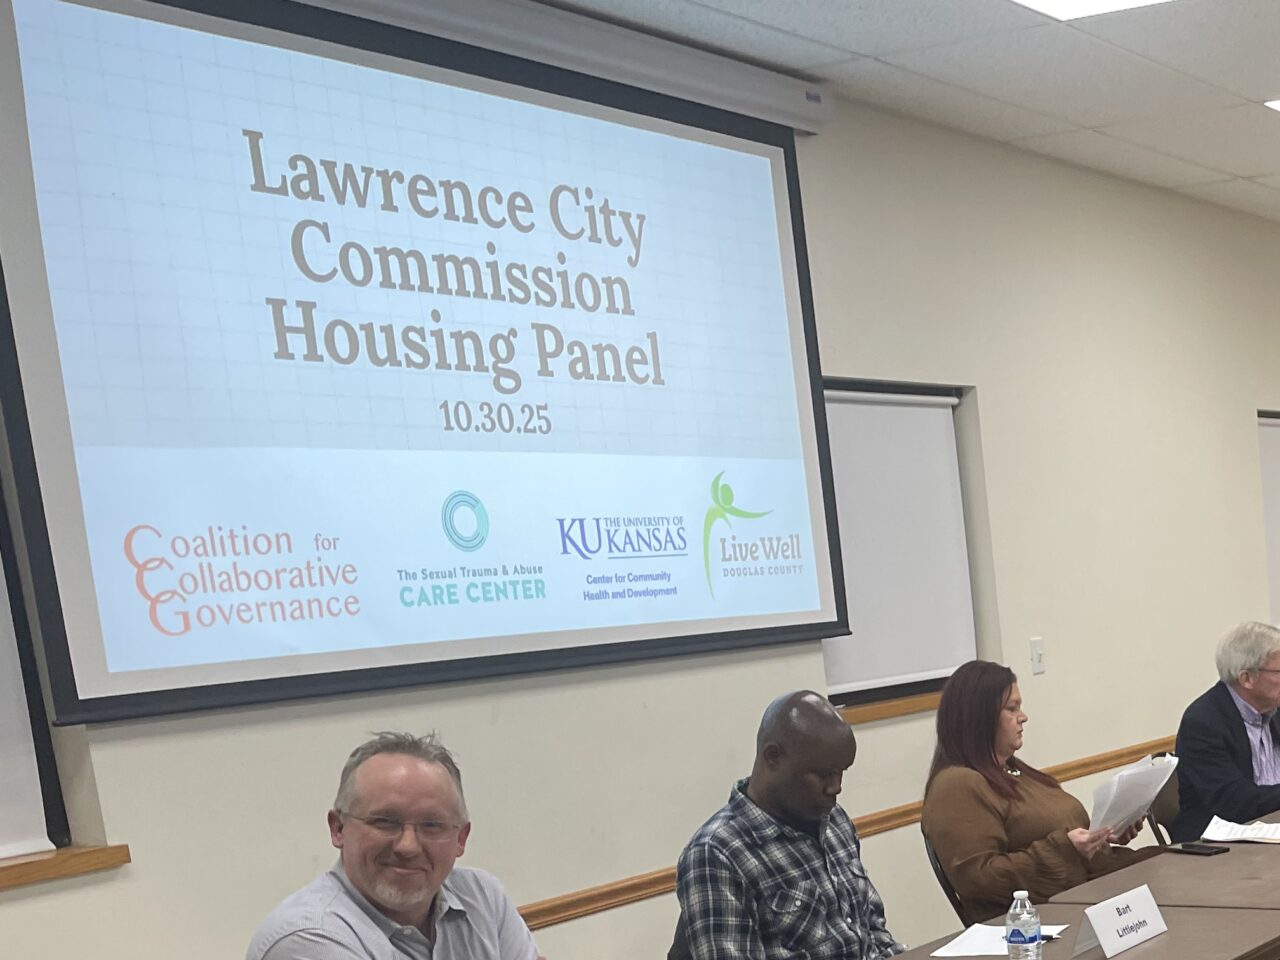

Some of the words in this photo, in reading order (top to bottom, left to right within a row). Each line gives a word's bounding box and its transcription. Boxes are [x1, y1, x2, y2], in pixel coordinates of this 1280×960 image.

[242, 128, 535, 233] Lawrence
[549, 184, 646, 268] City
[290, 219, 635, 316] Commission
[265, 297, 522, 395] Housing
[530, 322, 665, 386] Panel
[439, 400, 552, 434] 10.30.25
[604, 517, 621, 528] THE
[623, 516, 671, 527] UNIVERSITY
[672, 516, 684, 526] OF
[123, 524, 293, 570] Coalition
[313, 533, 340, 552] for
[556, 517, 602, 560] KU
[605, 526, 687, 553] KANSAS
[135, 556, 358, 602] Collaborative
[397, 569, 418, 581] The
[421, 567, 457, 580] Sexual
[460, 566, 498, 578] Trauma
[513, 564, 543, 575] Abuse
[586, 574, 613, 584] Center
[615, 572, 626, 583] for
[627, 571, 671, 583] Community
[722, 566, 764, 577] DOUGLAS
[768, 565, 803, 576] COUNTY
[400, 583, 460, 607] CARE
[465, 579, 546, 603] CENTER
[583, 589, 610, 600] Health
[611, 588, 626, 599] and
[627, 586, 677, 598] Development
[149, 590, 361, 637] Governance
[1115, 904, 1132, 917] Bart
[1116, 919, 1148, 938] Littlejohn
